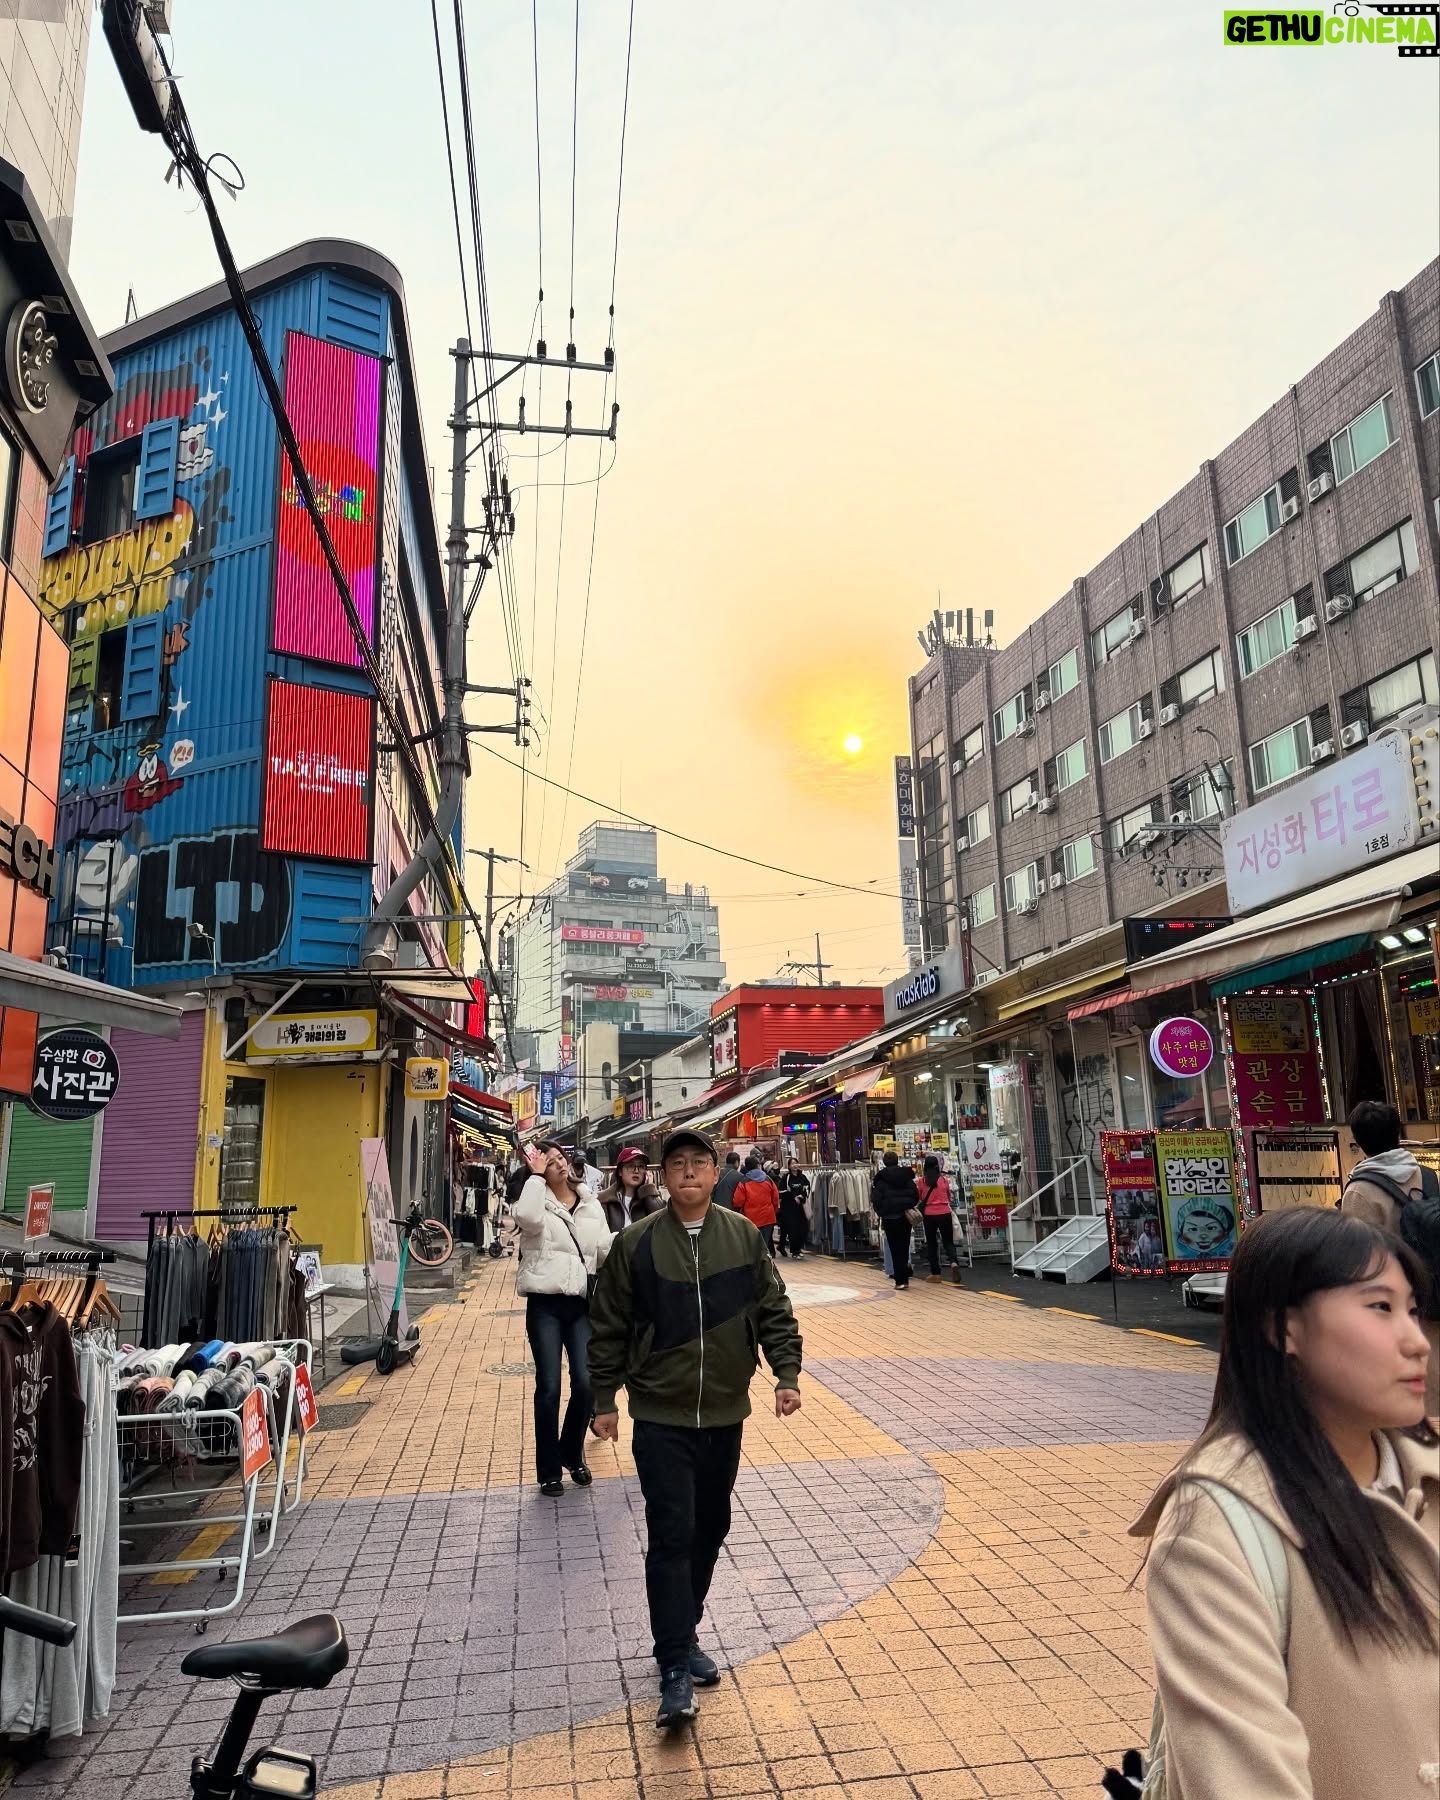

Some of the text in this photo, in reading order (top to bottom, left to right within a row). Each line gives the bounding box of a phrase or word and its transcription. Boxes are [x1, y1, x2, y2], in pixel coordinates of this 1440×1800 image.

[898, 772, 913, 834] 호미화방
[1237, 767, 1390, 875] 지성화 타로
[1365, 833, 1390, 855] 1호점
[895, 967, 938, 1010] masklab
[40, 1046, 78, 1064] 수상한
[1178, 1056, 1198, 1068] 맛집
[34, 1066, 115, 1102] 사진관
[543, 1082, 552, 1114] 부동산
[1164, 1157, 1231, 1179] 화성인
[1167, 1178, 1233, 1195] 바이러스
